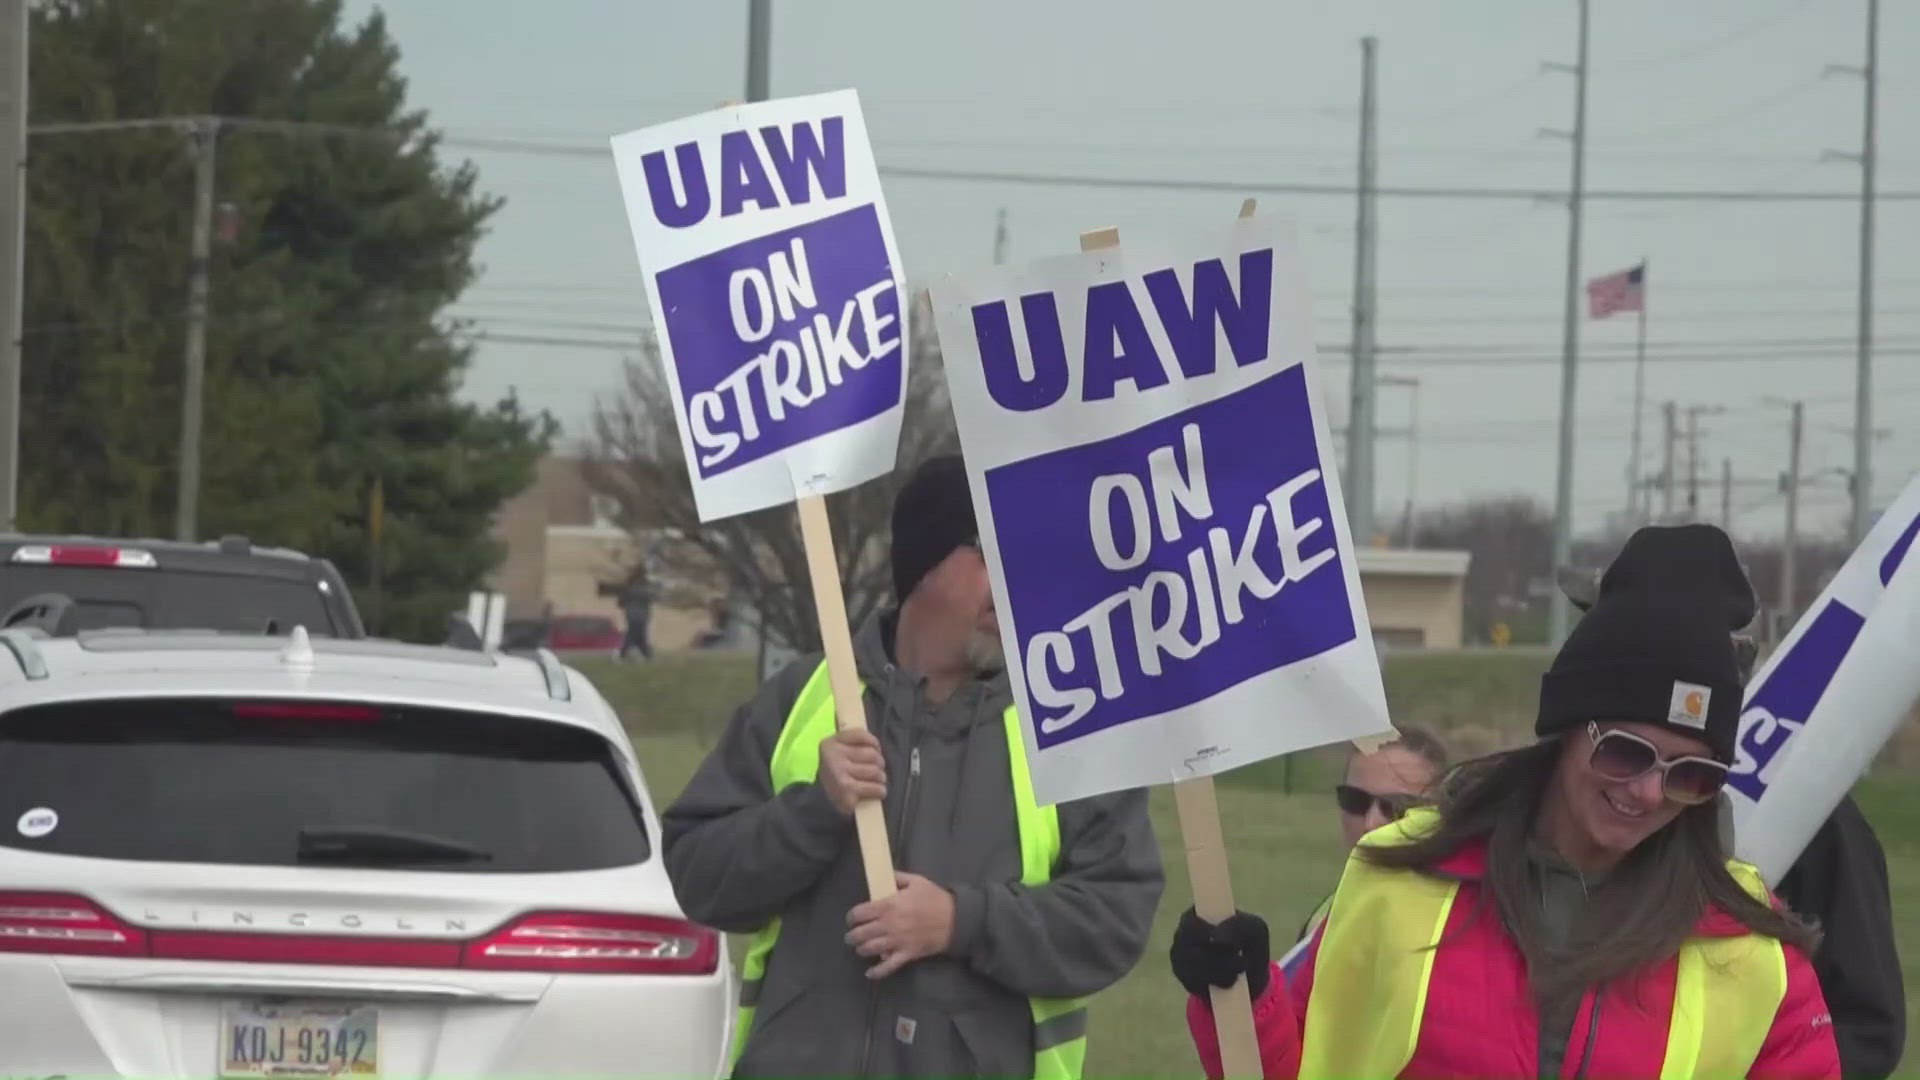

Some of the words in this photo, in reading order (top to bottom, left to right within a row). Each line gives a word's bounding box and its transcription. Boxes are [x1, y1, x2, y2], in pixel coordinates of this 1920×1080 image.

[641, 116, 847, 228] UAW
[729, 237, 818, 343] ON
[971, 248, 1273, 412] UAW
[690, 279, 901, 468] STRIKE
[1089, 422, 1213, 571] ON
[1026, 469, 1336, 734] STRIKE
[144, 909, 466, 931] LINCOLN
